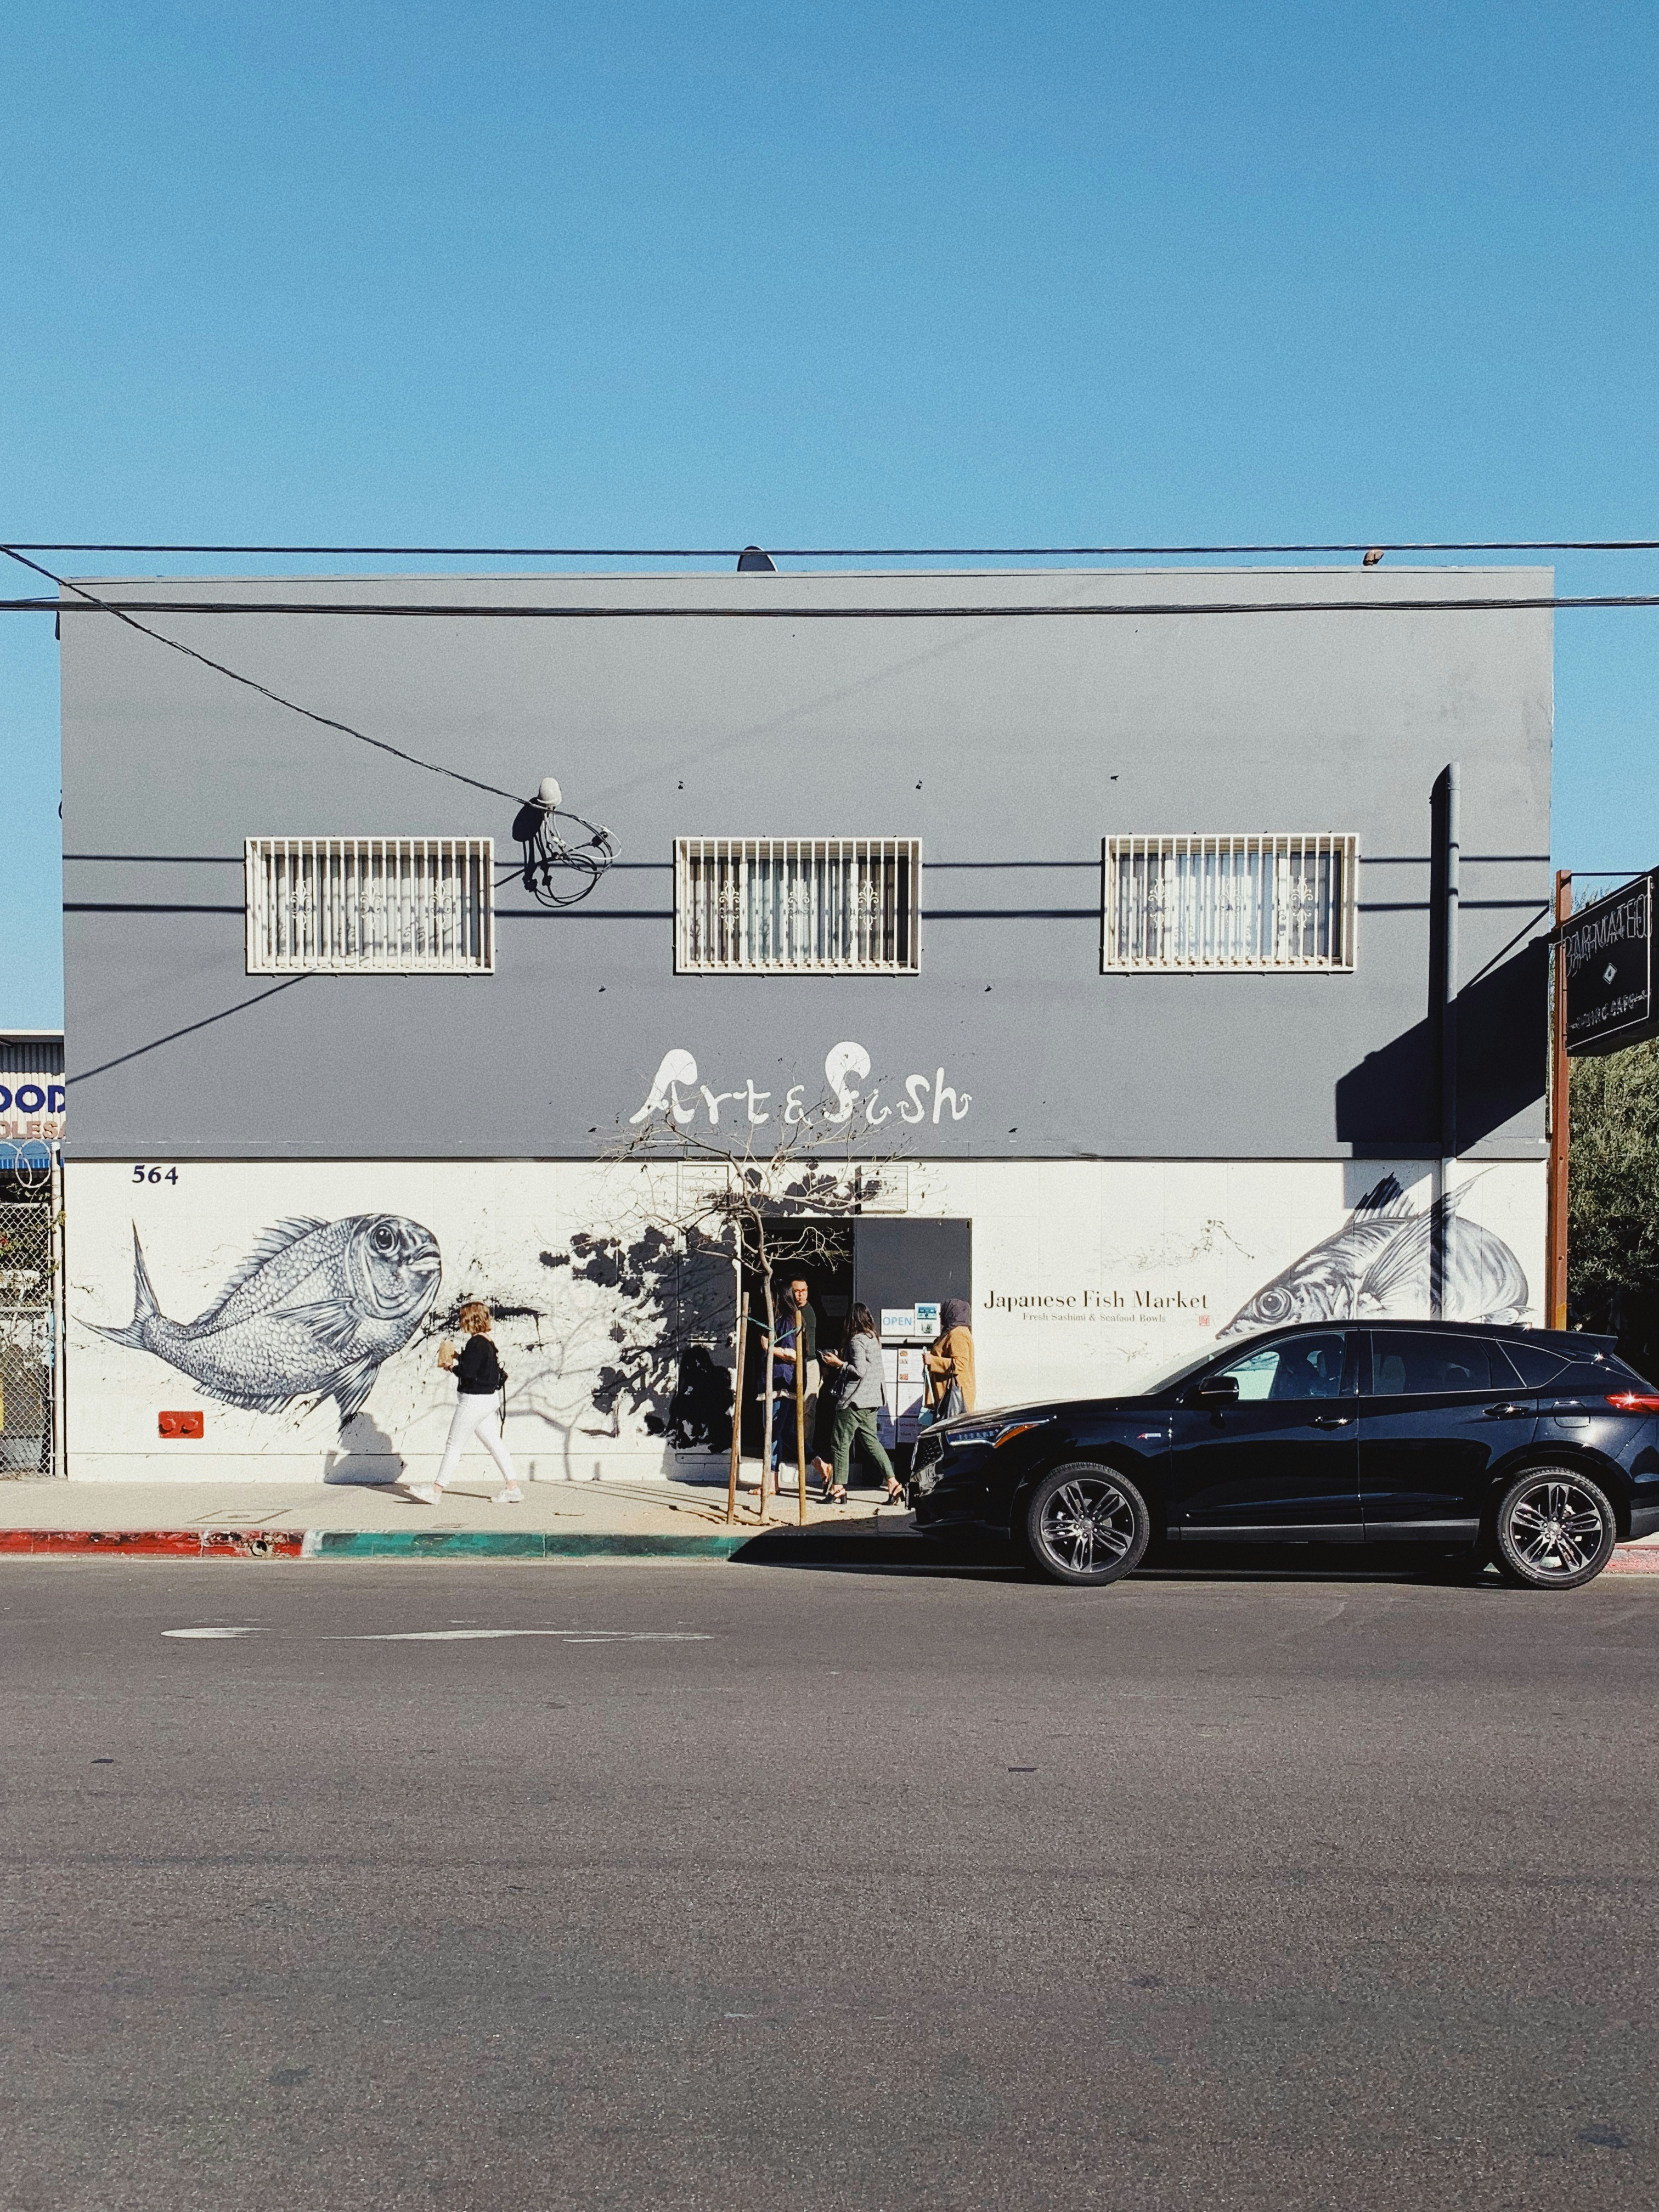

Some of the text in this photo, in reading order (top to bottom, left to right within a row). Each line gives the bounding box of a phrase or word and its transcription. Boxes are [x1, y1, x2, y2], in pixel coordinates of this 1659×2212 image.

[629, 1041, 973, 1125] Art & Fish
[132, 1165, 178, 1186] 564
[984, 1290, 1210, 1312] Japanese Fish Market
[882, 1316, 912, 1326] OPEN
[1023, 1312, 1166, 1323] Fresh Sashimi & Seafood Bowls
